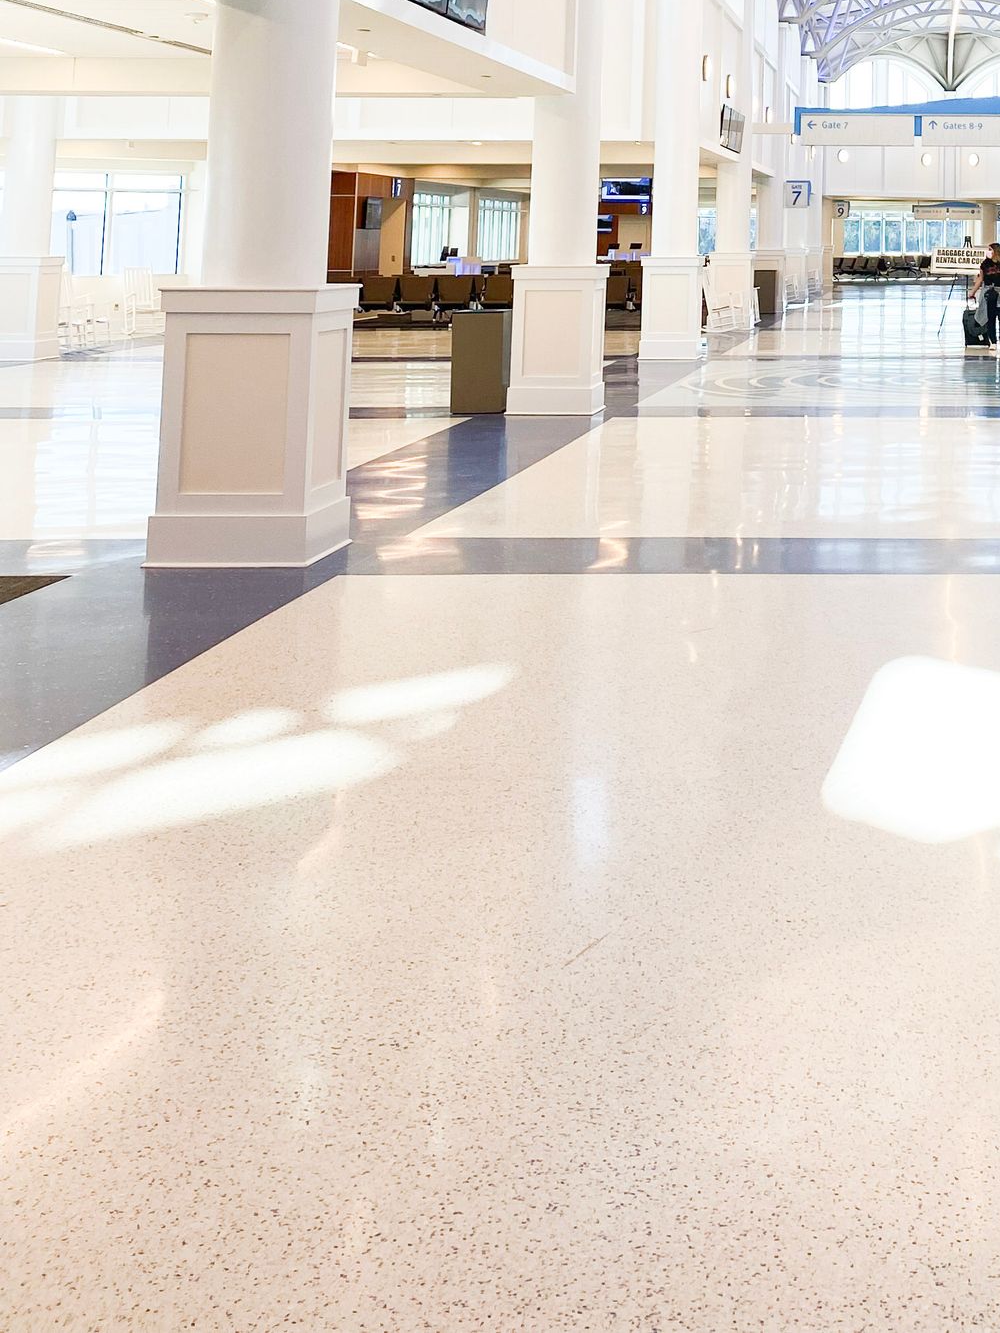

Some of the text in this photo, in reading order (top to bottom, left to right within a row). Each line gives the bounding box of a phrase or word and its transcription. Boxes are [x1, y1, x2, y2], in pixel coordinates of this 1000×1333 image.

[821, 121, 849, 130] Gate 7
[943, 122, 983, 131] Gates 8-9
[791, 191, 802, 206] 7
[837, 207, 845, 218] 9
[937, 249, 965, 257] BAGGAGE
[935, 256, 957, 264] RENTAL
